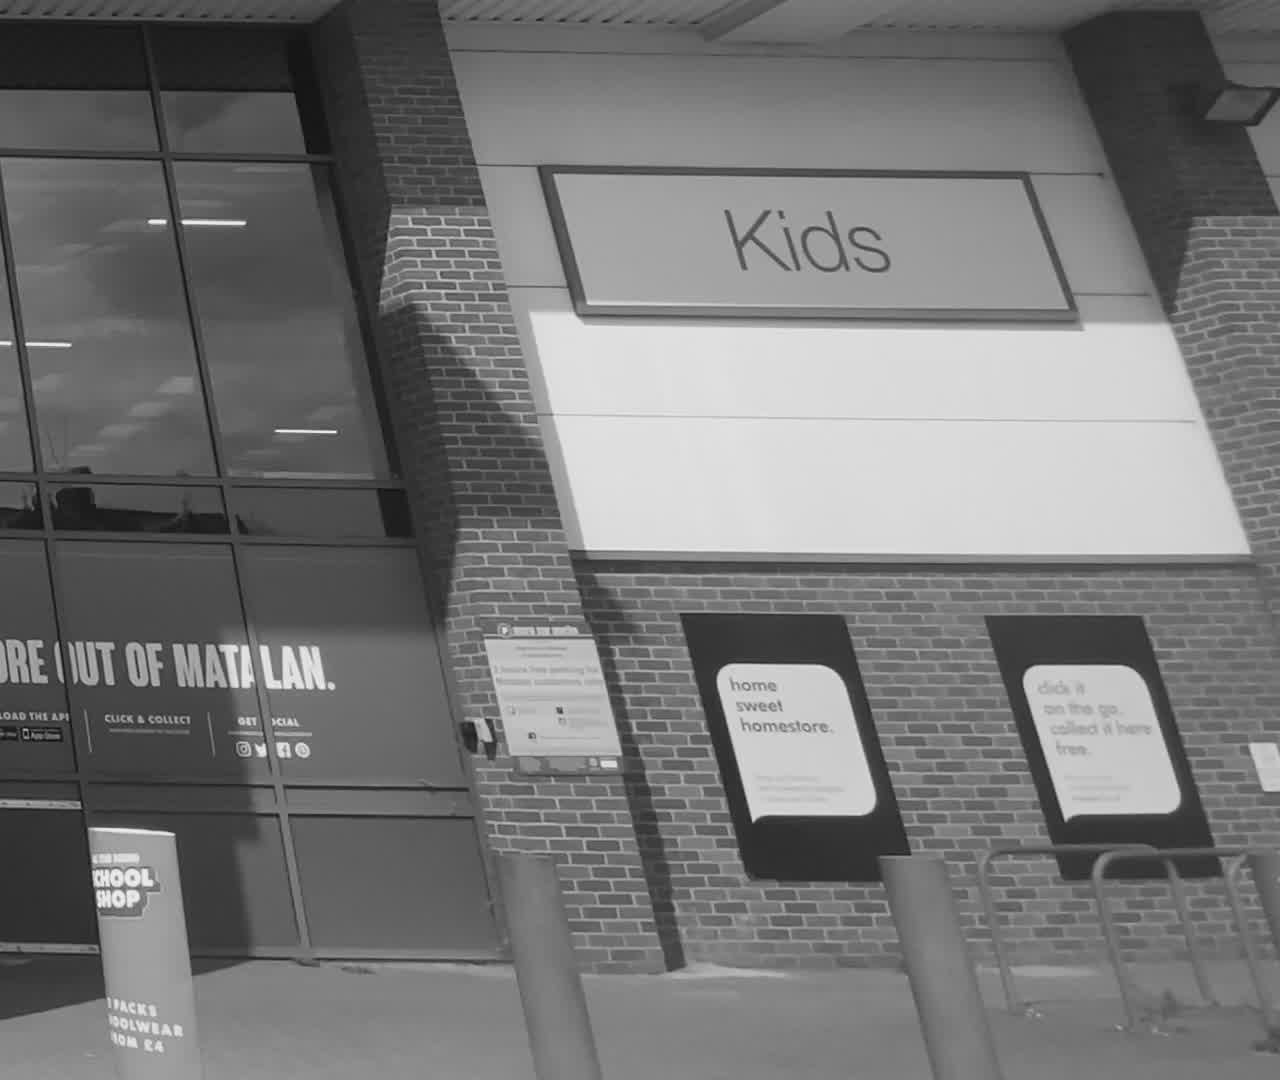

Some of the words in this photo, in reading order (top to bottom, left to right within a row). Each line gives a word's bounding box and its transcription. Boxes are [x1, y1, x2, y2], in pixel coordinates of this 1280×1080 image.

[723, 209, 892, 274] Kids
[125, 642, 163, 687] OF
[730, 677, 777, 692] home
[736, 700, 783, 713] sweet
[104, 713, 135, 725] CLICK
[148, 714, 191, 726] COLLECT
[237, 716, 258, 727] GET
[739, 717, 836, 734] homestore.
[92, 867, 154, 888] CHOOL
